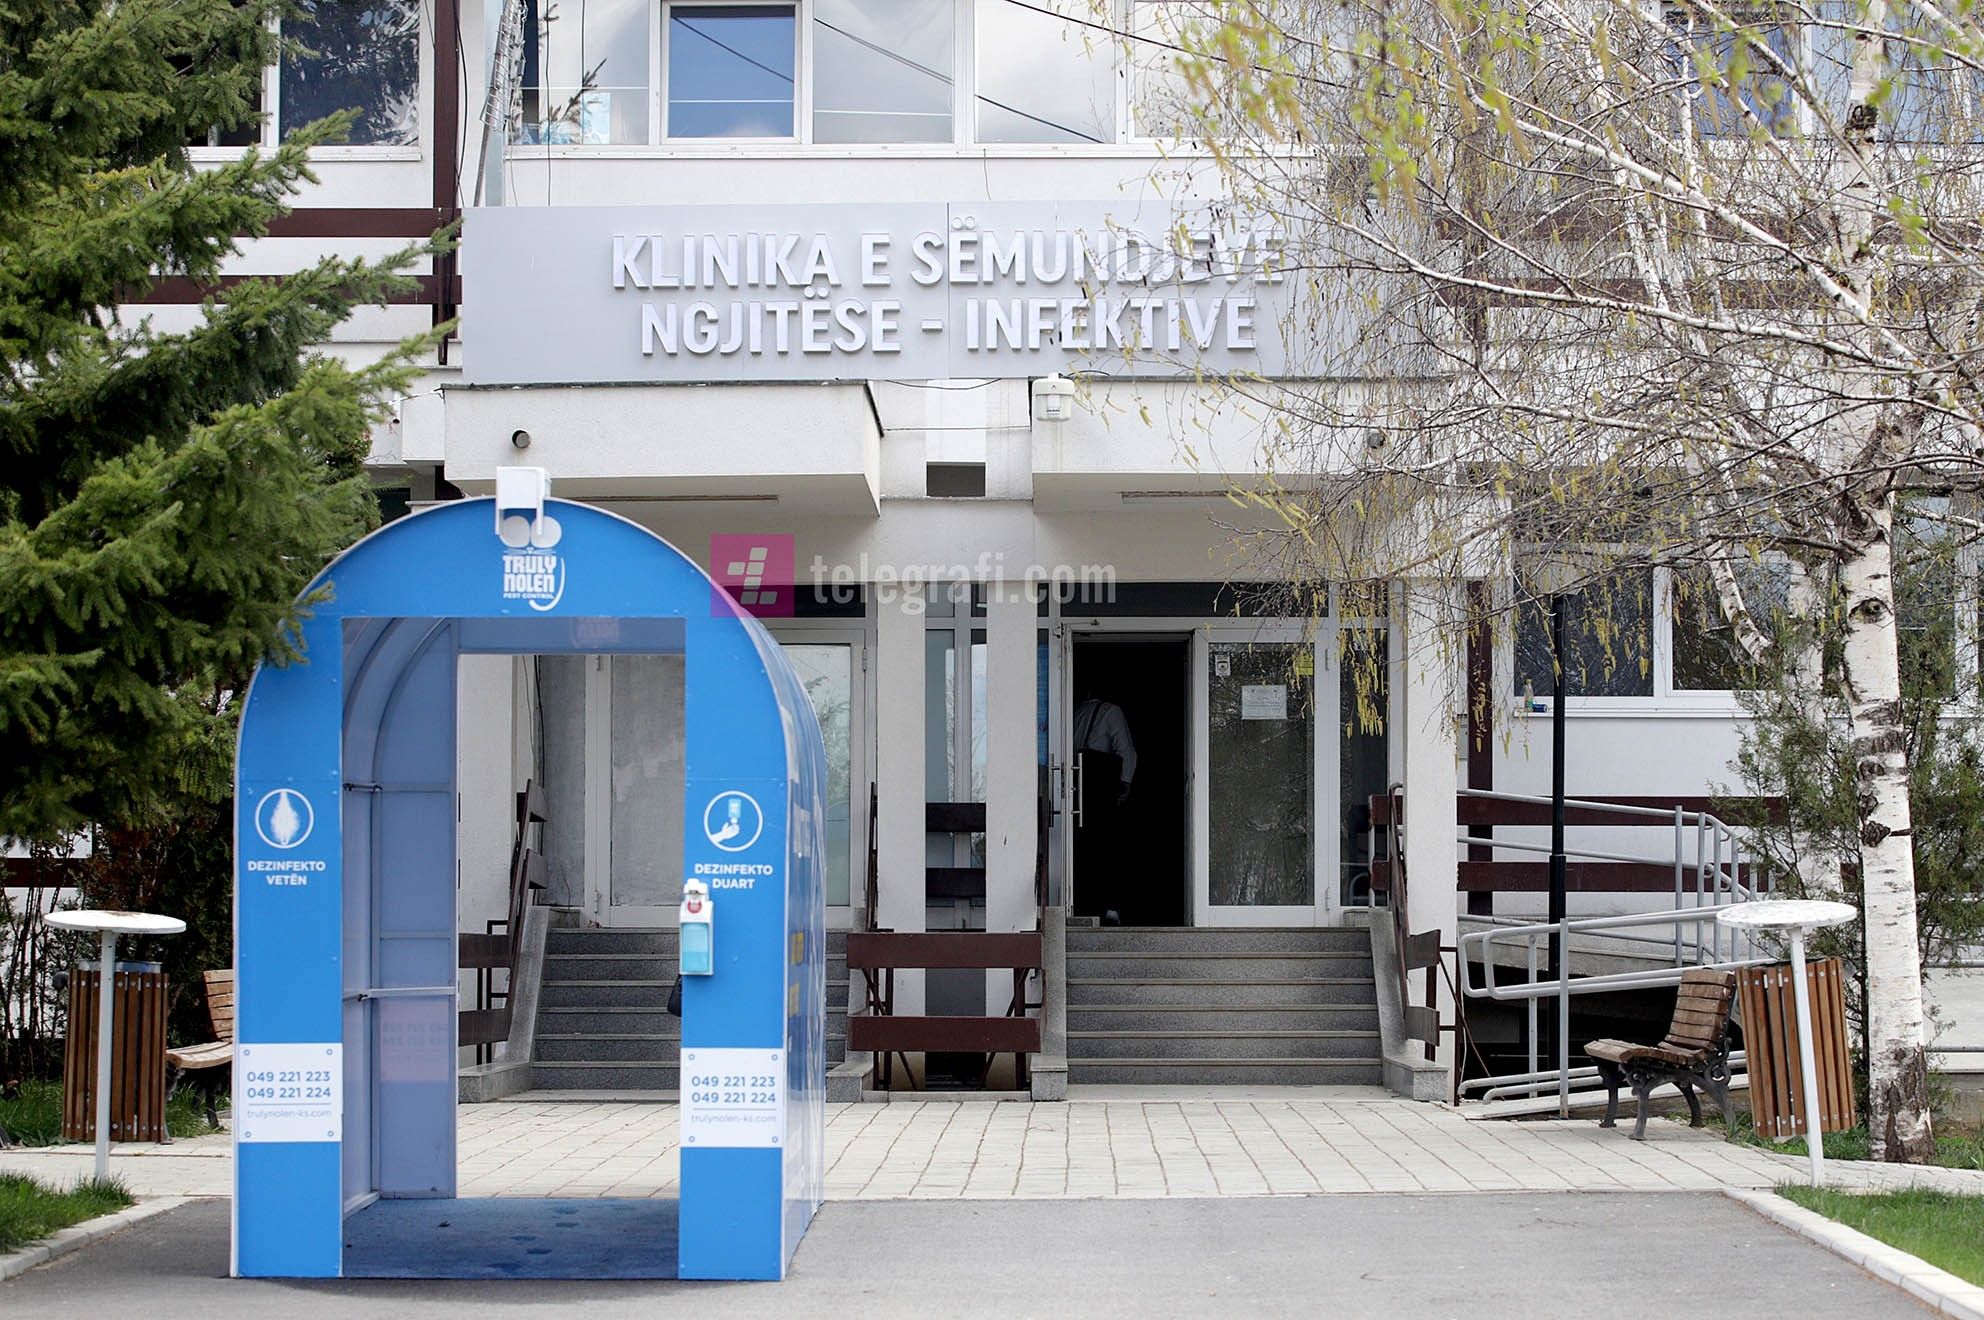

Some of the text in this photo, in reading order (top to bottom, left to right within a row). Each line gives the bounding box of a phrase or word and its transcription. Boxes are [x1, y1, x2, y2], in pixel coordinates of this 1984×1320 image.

[612, 215, 1285, 289] KLINIKA E SËMUNDJEVE
[641, 285, 902, 355] NGJITËSE
[966, 298, 1257, 352] INFEKTIVE
[502, 555, 557, 573] TRULY
[503, 574, 555, 593] NOLEN
[247, 861, 326, 871] DEZINFEKTO
[694, 863, 774, 875] DEZINFEKTO
[266, 873, 307, 886] VETËN
[712, 878, 756, 889] DUART
[247, 1071, 330, 1082] 049 221 223
[691, 1076, 776, 1087] 049 221 223
[247, 1087, 331, 1098] 049 221 224
[691, 1092, 776, 1103] 049 221 224
